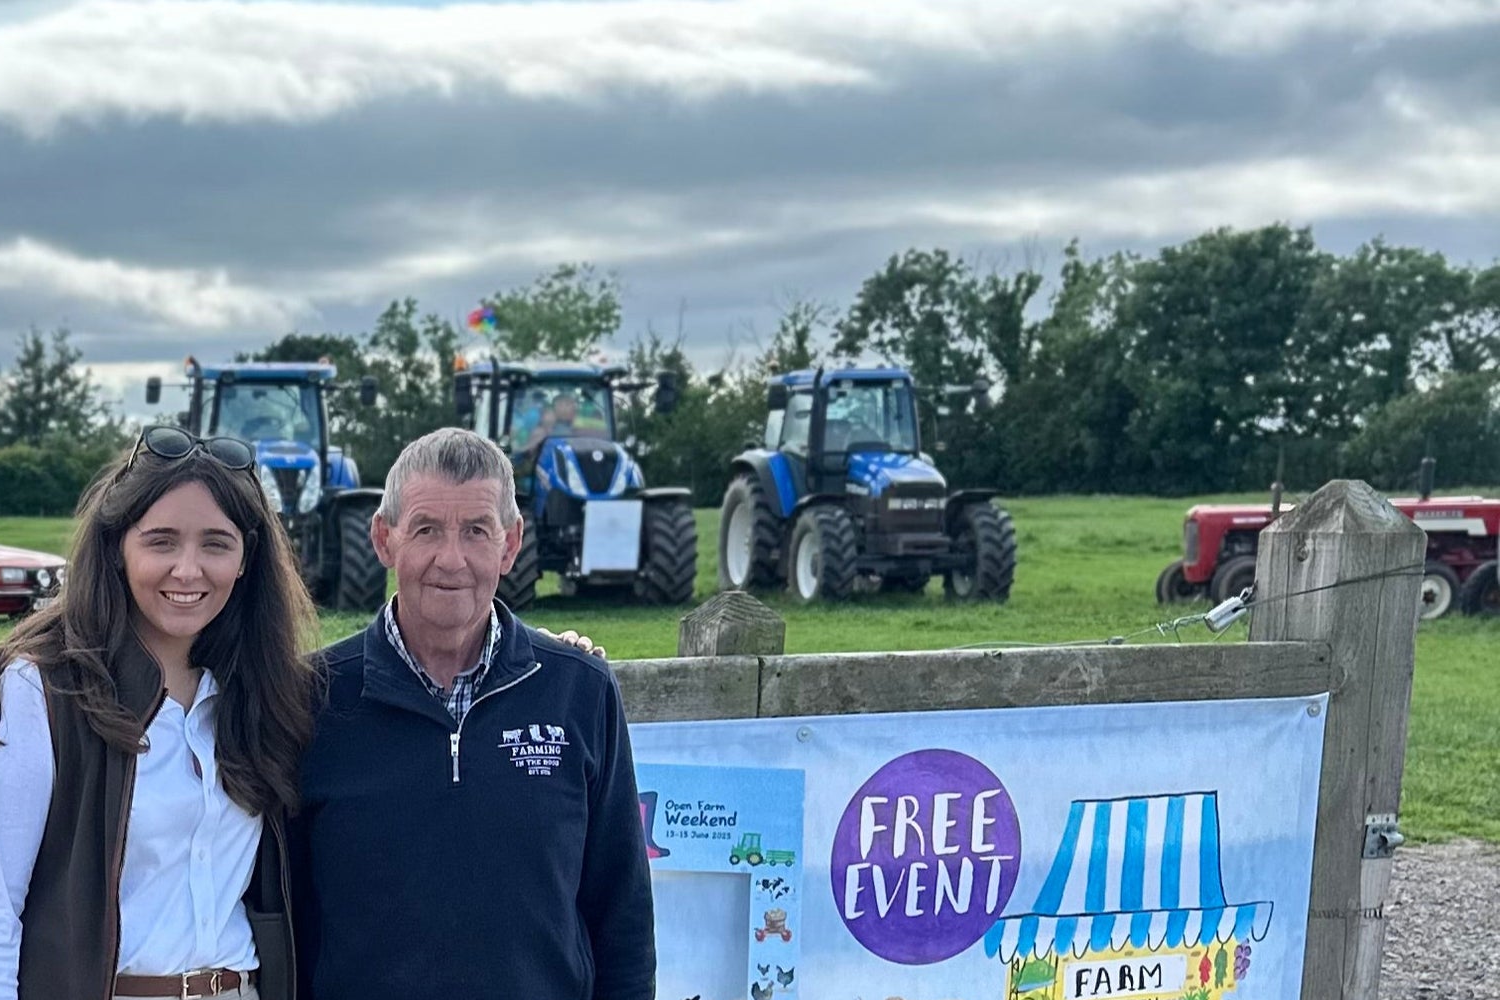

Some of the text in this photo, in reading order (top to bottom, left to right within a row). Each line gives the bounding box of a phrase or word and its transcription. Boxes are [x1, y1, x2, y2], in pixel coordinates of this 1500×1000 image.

[512, 745, 561, 756] FARMING
[665, 800, 726, 812] Open Farm
[665, 810, 737, 827] Weekend
[860, 789, 1003, 861] FREE
[845, 855, 1014, 920] EVENT
[1075, 962, 1162, 998] FARM
